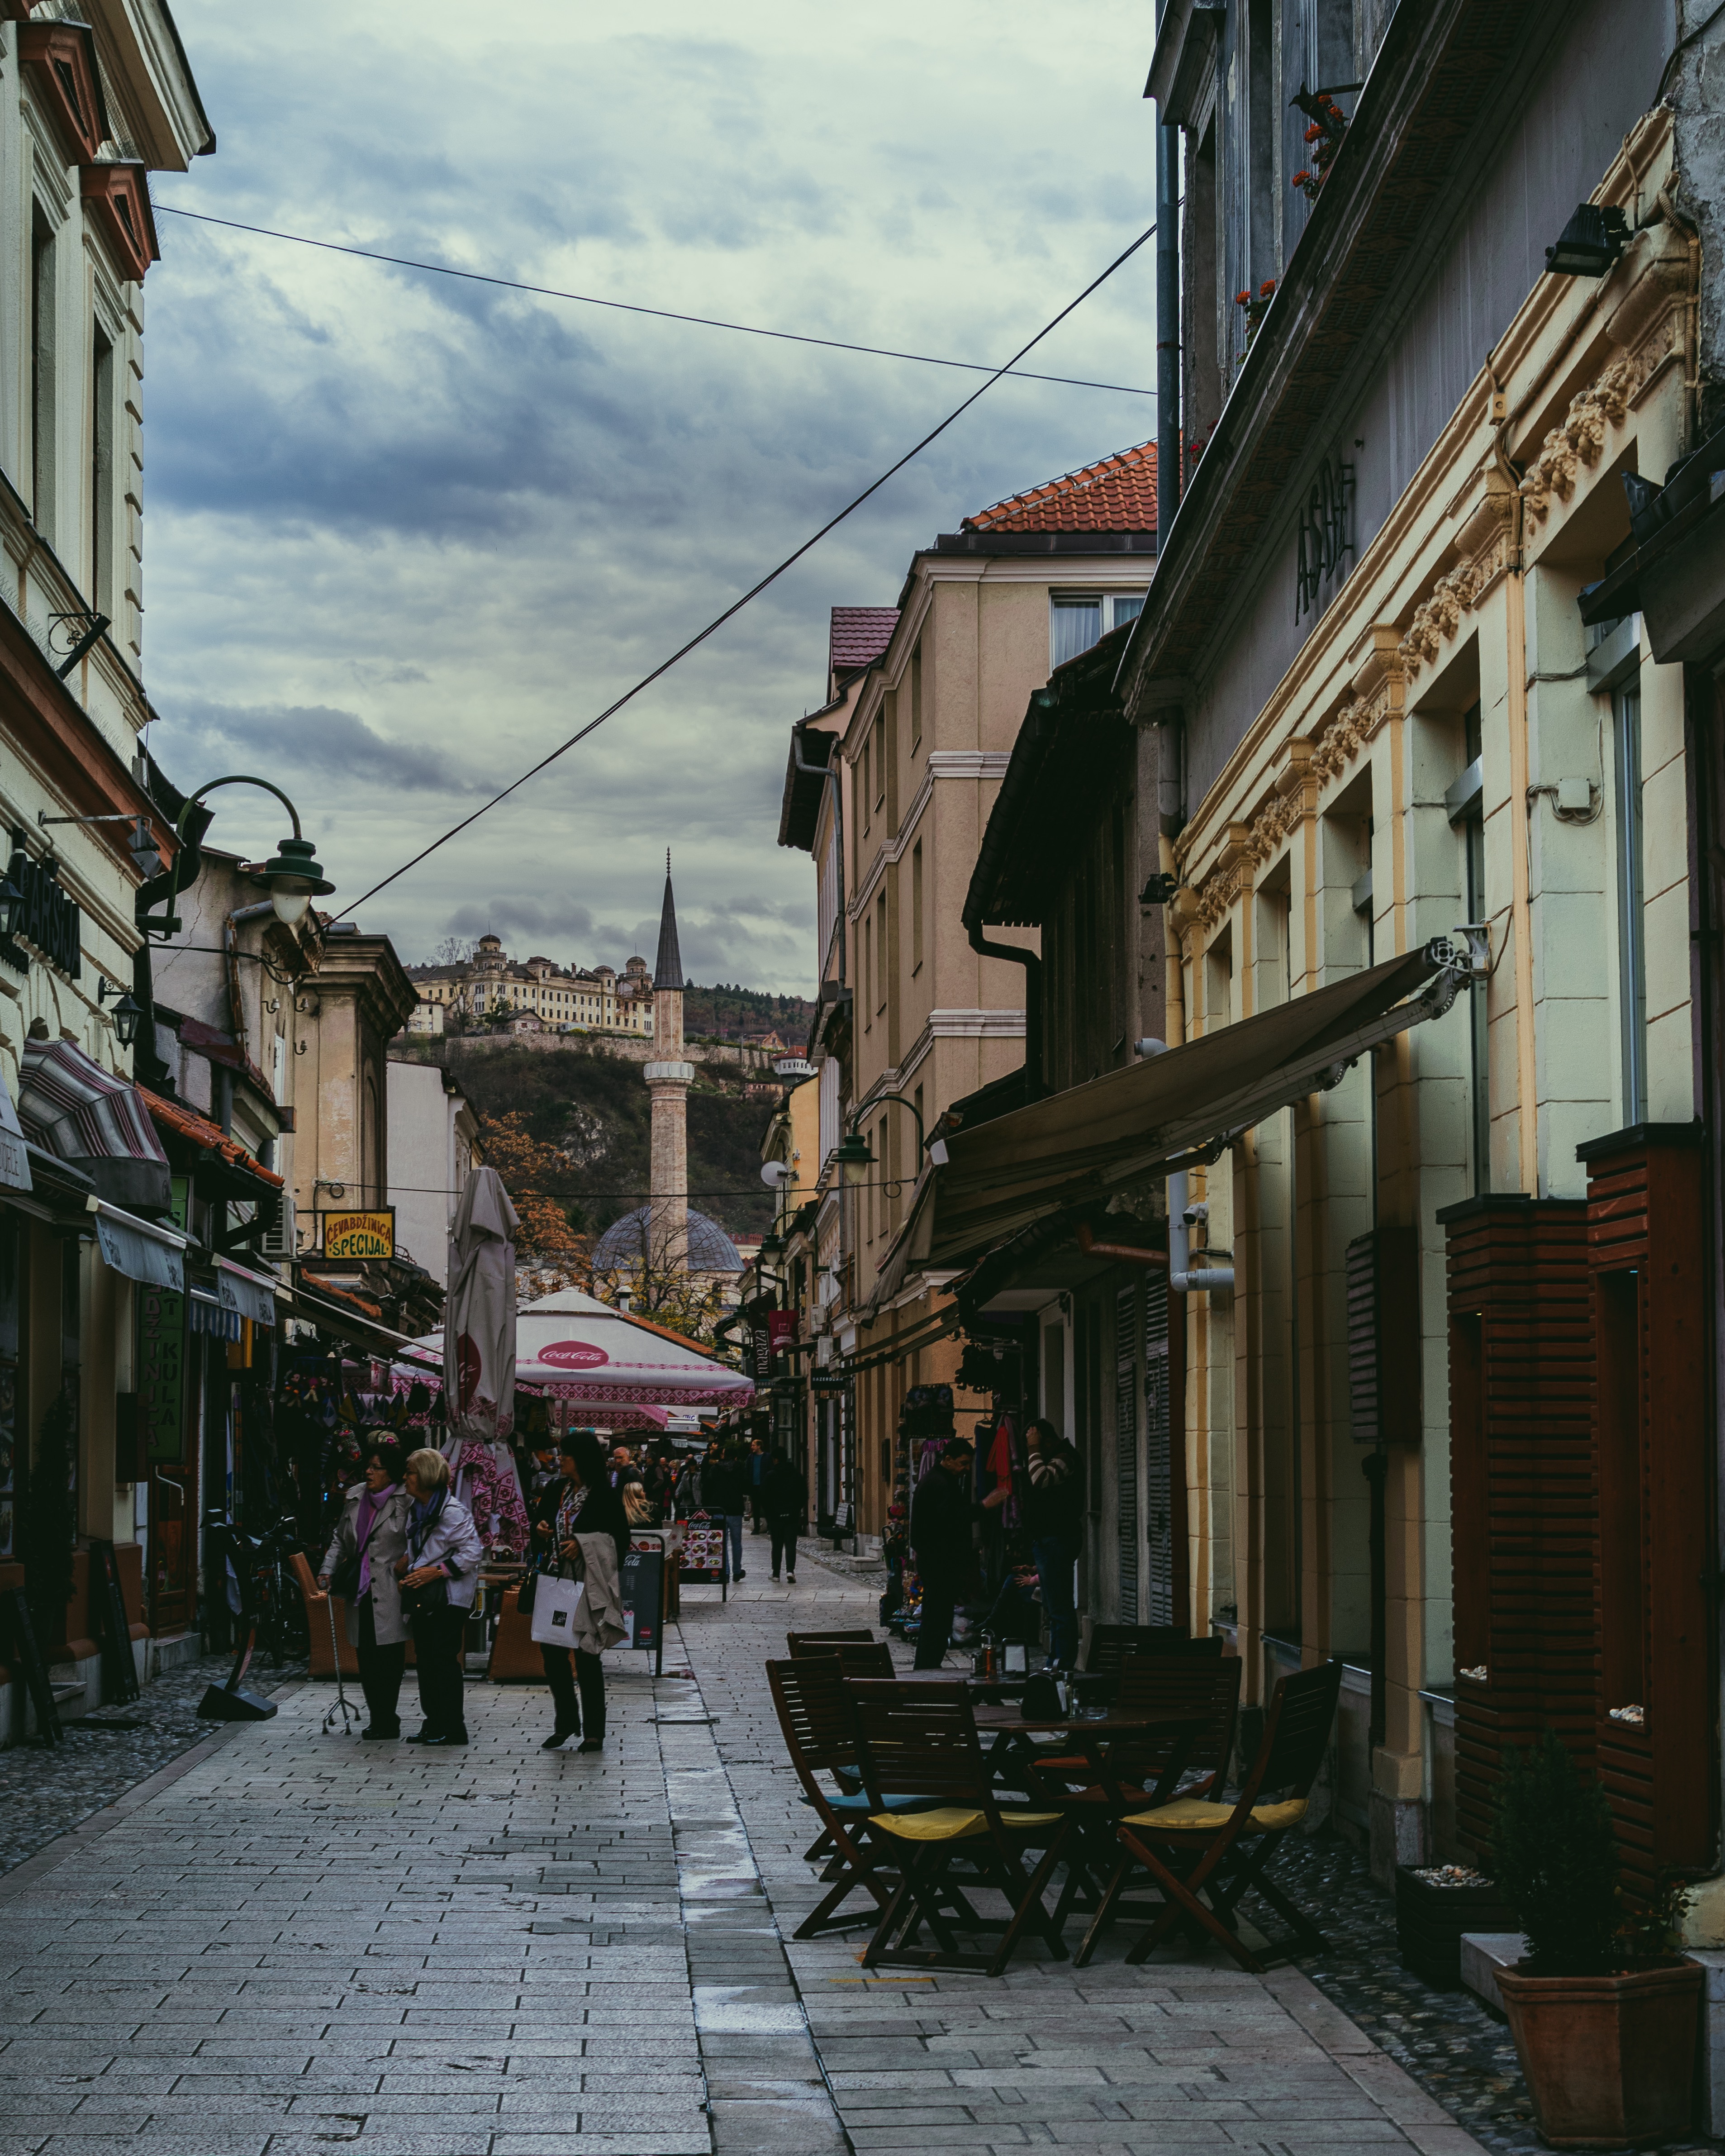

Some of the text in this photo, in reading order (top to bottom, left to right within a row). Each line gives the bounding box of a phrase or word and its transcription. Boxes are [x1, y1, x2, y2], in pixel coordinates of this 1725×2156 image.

[333, 1234, 386, 1256] SPECIJAL
[542, 1351, 605, 1361] Coca-Cola
[755, 1329, 770, 1374] magaza
[160, 1342, 178, 1426] KULA
